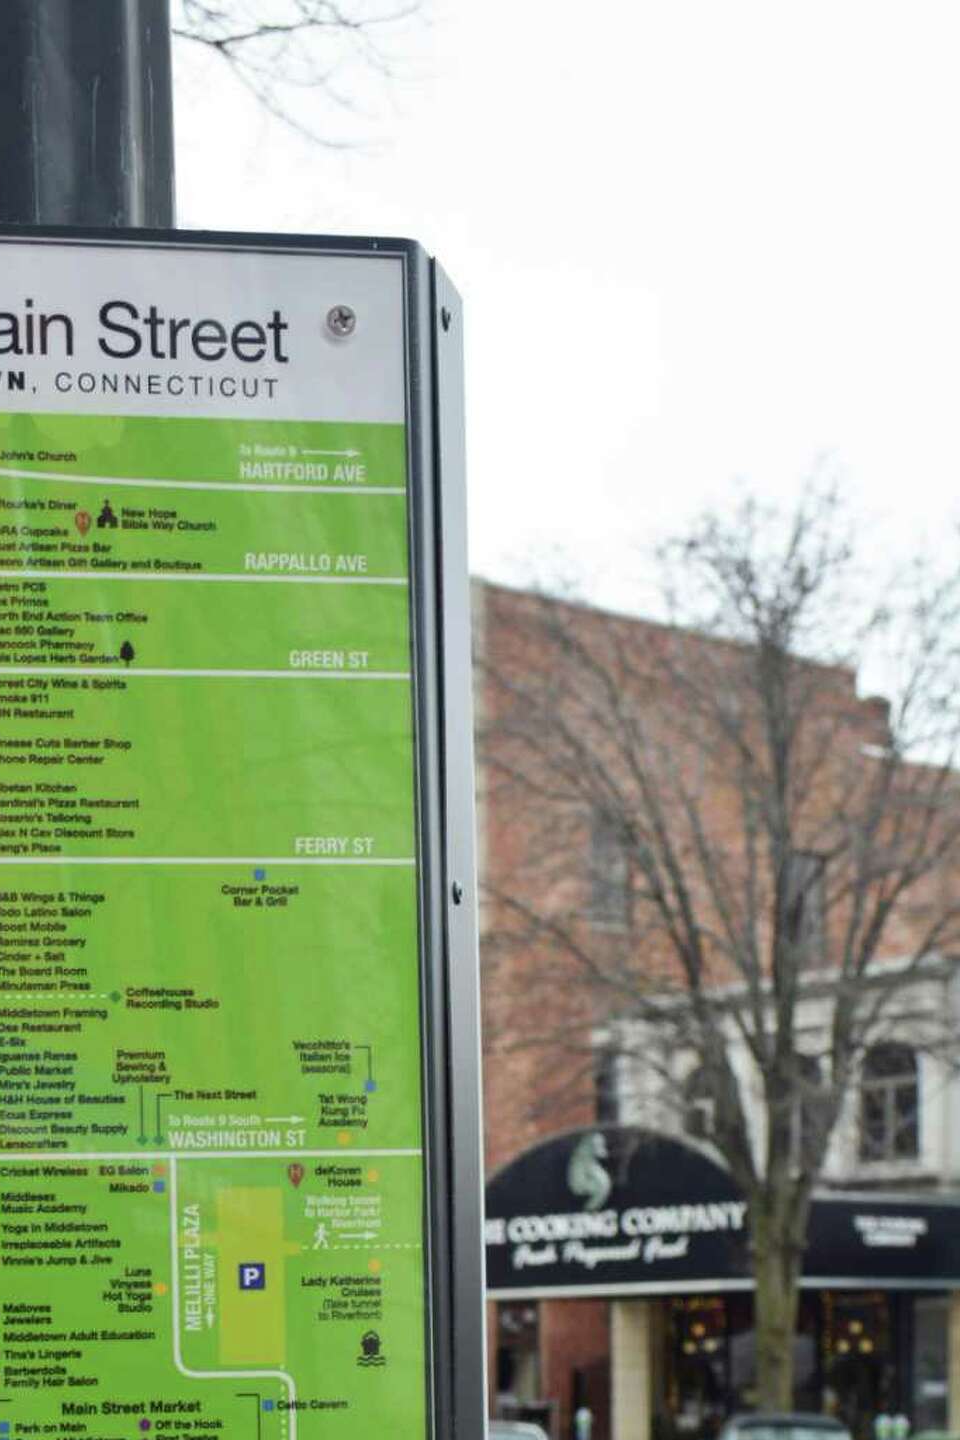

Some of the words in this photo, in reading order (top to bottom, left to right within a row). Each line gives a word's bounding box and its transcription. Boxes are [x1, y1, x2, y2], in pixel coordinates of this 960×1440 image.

[98, 302, 288, 365] Street
[55, 372, 279, 398] CONNECTICUT
[240, 463, 329, 481] HARTFORD
[334, 465, 365, 482] AVE
[245, 553, 331, 571] RAPPALLO
[336, 554, 367, 572] AVE
[289, 650, 340, 666] GREEN
[346, 651, 369, 667] ST
[29, 754, 64, 767] Repair
[68, 754, 104, 765] Center
[295, 838, 346, 854] FERRY
[352, 838, 374, 854] ST
[221, 885, 257, 896] Corner
[261, 885, 298, 896] Pocket
[19, 966, 50, 977] Board
[53, 966, 87, 977] Room
[169, 1131, 276, 1148] WASHINGTON
[281, 1130, 306, 1147] ST
[62, 1402, 98, 1415] Main
[102, 1401, 145, 1414] Street
[150, 1401, 201, 1413] Market
